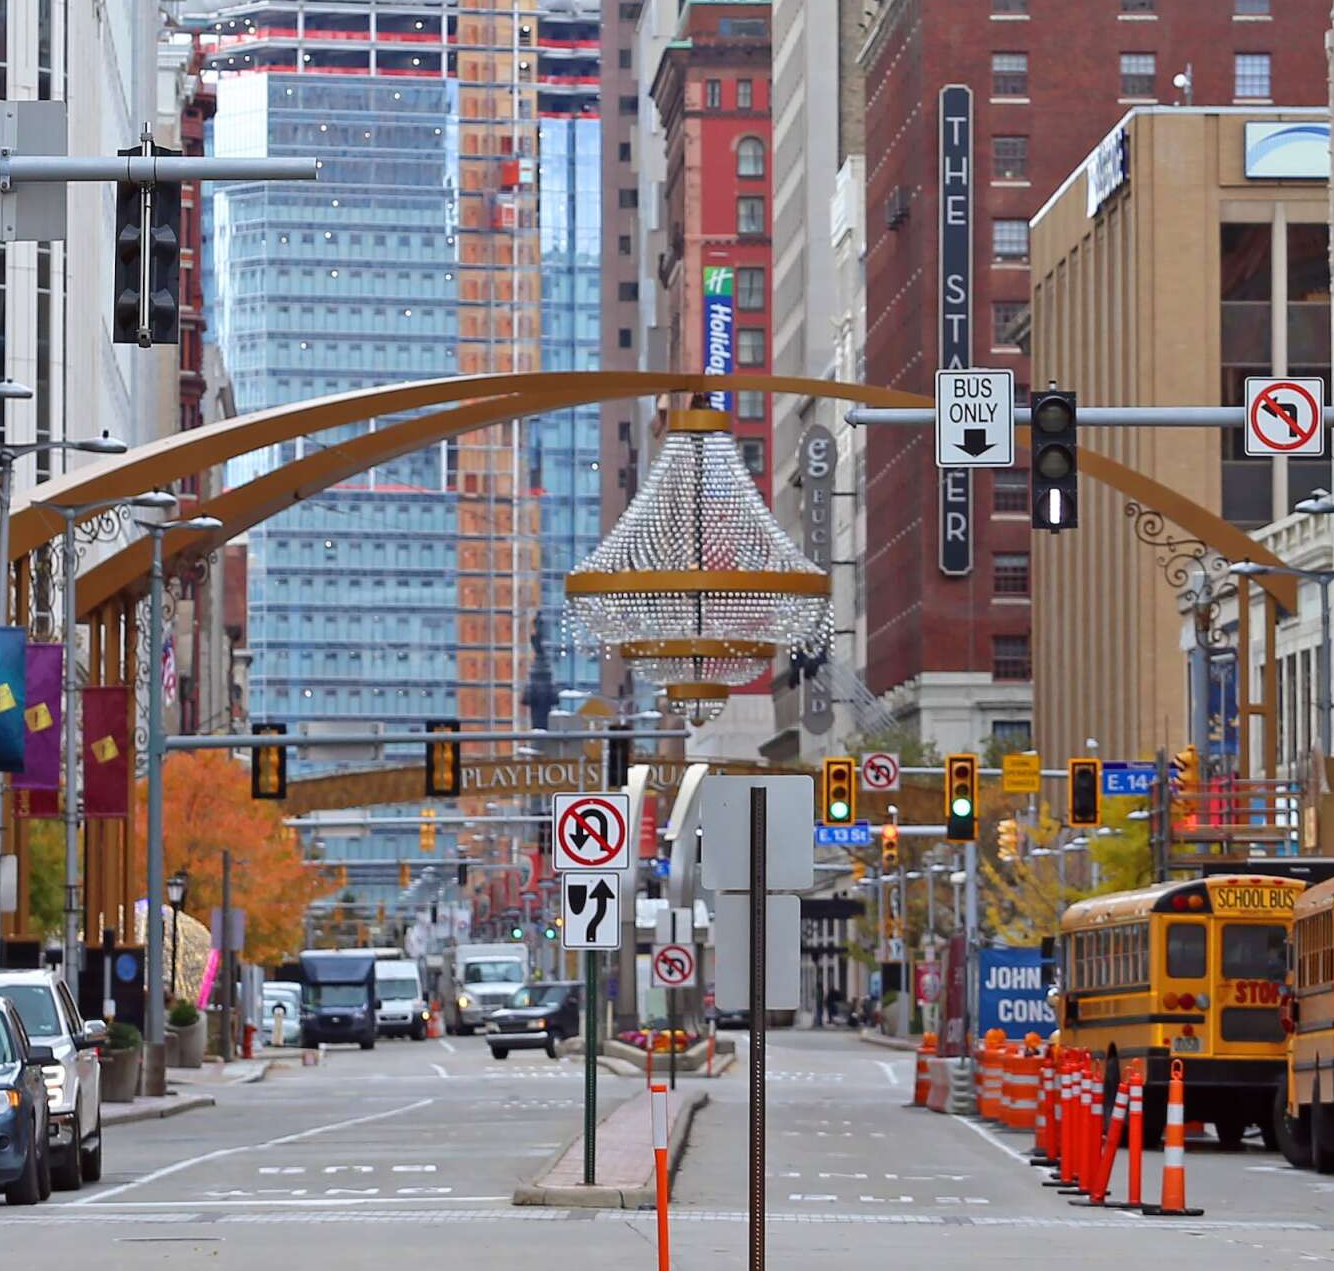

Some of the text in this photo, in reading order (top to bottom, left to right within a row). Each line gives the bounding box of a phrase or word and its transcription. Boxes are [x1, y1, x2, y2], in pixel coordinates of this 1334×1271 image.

[945, 116, 968, 543] THE STAER
[953, 378, 993, 399] BUS
[949, 402, 998, 425] ONLY
[1107, 774, 1150, 791] E. 14
[818, 828, 867, 842] E. 13 St
[1218, 888, 1295, 909] SCHOOL BUS
[985, 966, 1041, 990] JOHN
[998, 999, 1057, 1022] CONS
